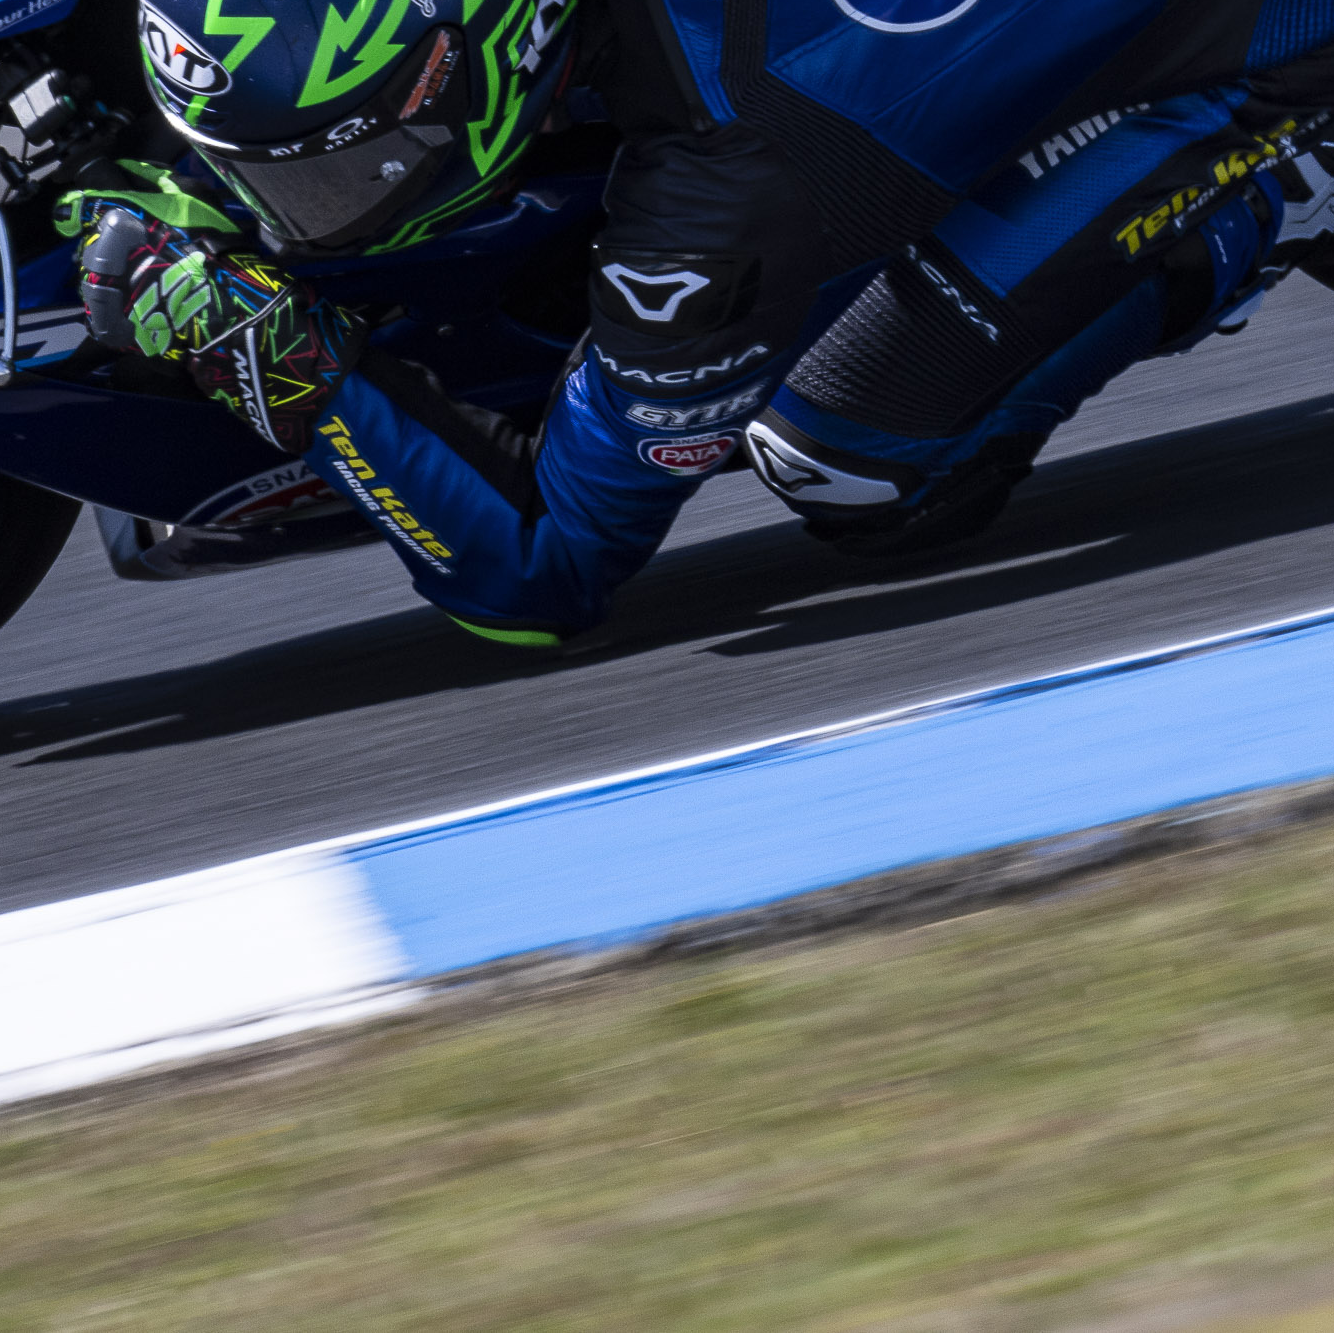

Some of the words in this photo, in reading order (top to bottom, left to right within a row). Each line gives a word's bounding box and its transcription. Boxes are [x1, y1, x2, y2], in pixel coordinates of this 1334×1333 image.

[1018, 102, 1151, 180] YAM
[593, 344, 768, 383] MACNA
[232, 348, 272, 444] MACN
[627, 382, 765, 426] GYTR
[660, 444, 722, 463] PATA
[672, 433, 718, 446] SNACK
[252, 466, 313, 495] SNA
[319, 415, 377, 481] Ten
[371, 487, 453, 559] Kate
[332, 461, 380, 513] RACING
[377, 515, 452, 576] PRODUCTS
